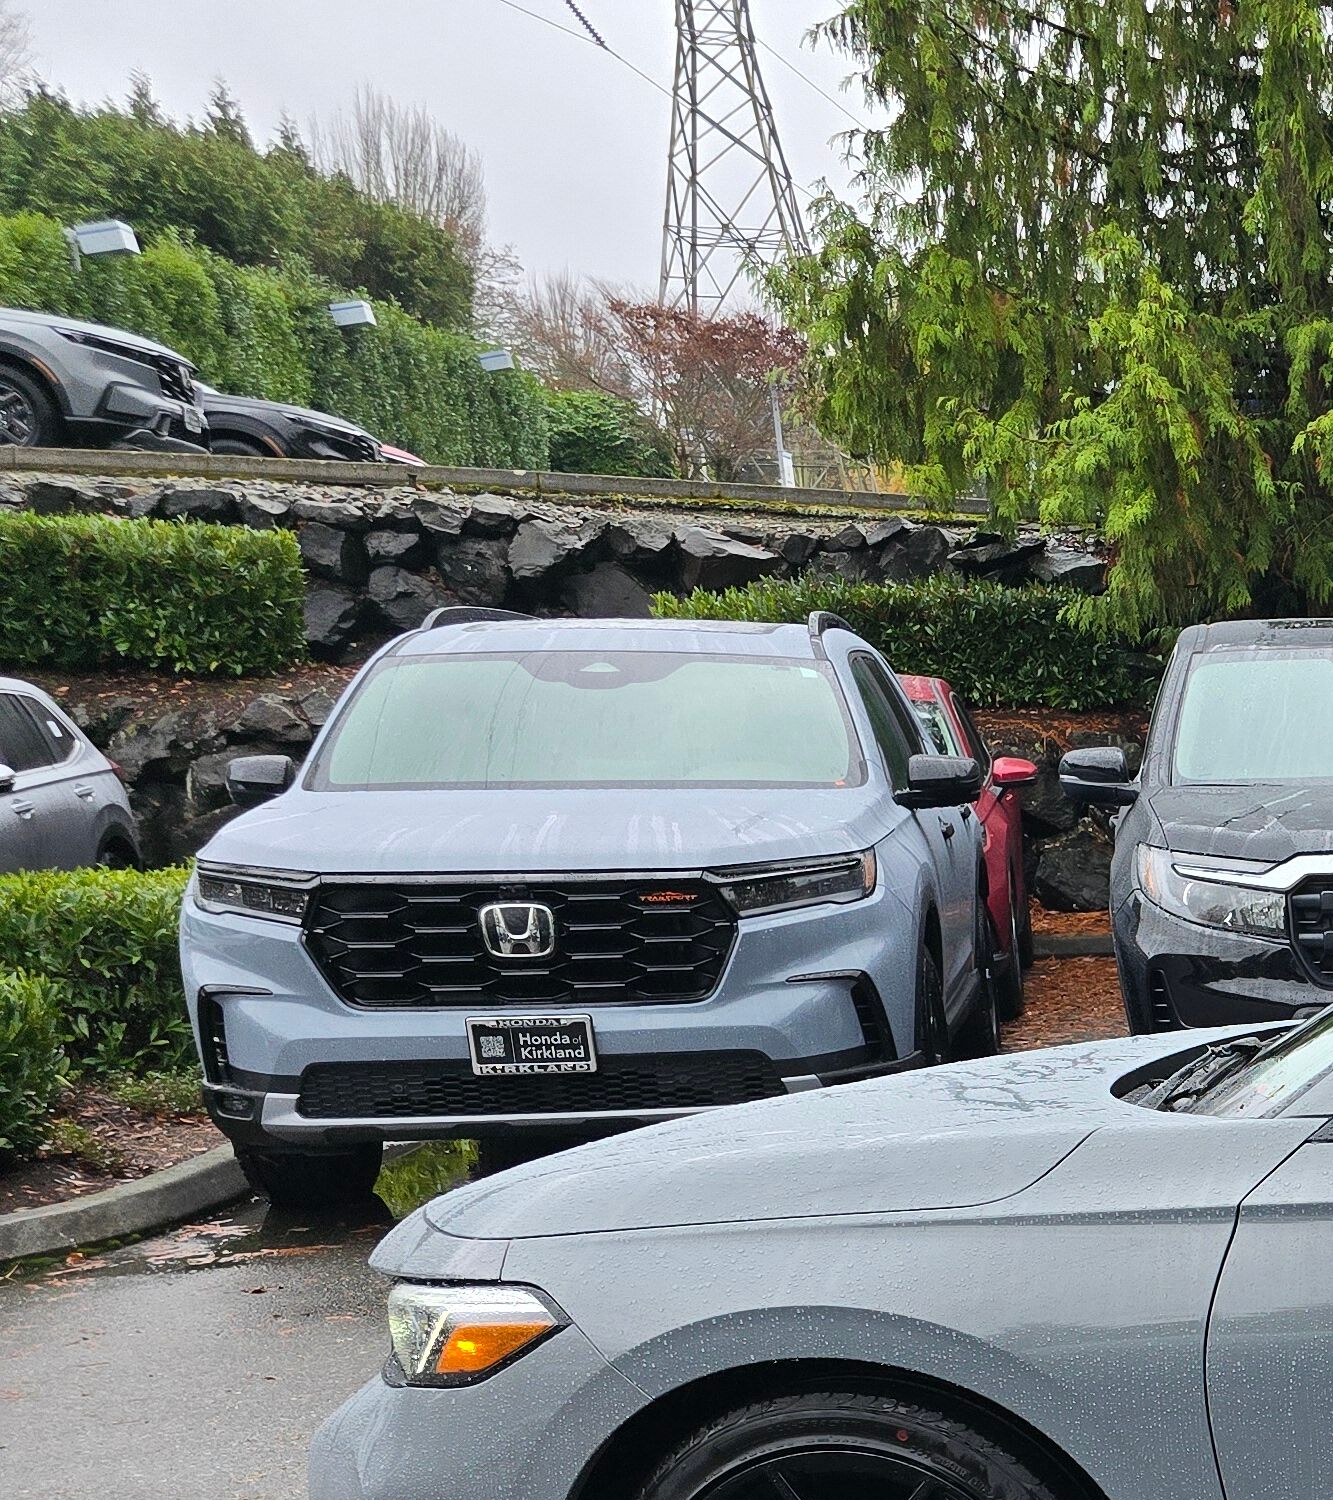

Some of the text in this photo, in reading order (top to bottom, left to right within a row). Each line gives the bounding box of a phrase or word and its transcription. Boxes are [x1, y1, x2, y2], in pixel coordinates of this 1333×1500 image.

[499, 1019, 559, 1029] HONDA
[518, 1032, 582, 1045] Honda of
[520, 1045, 585, 1059] Kirkland
